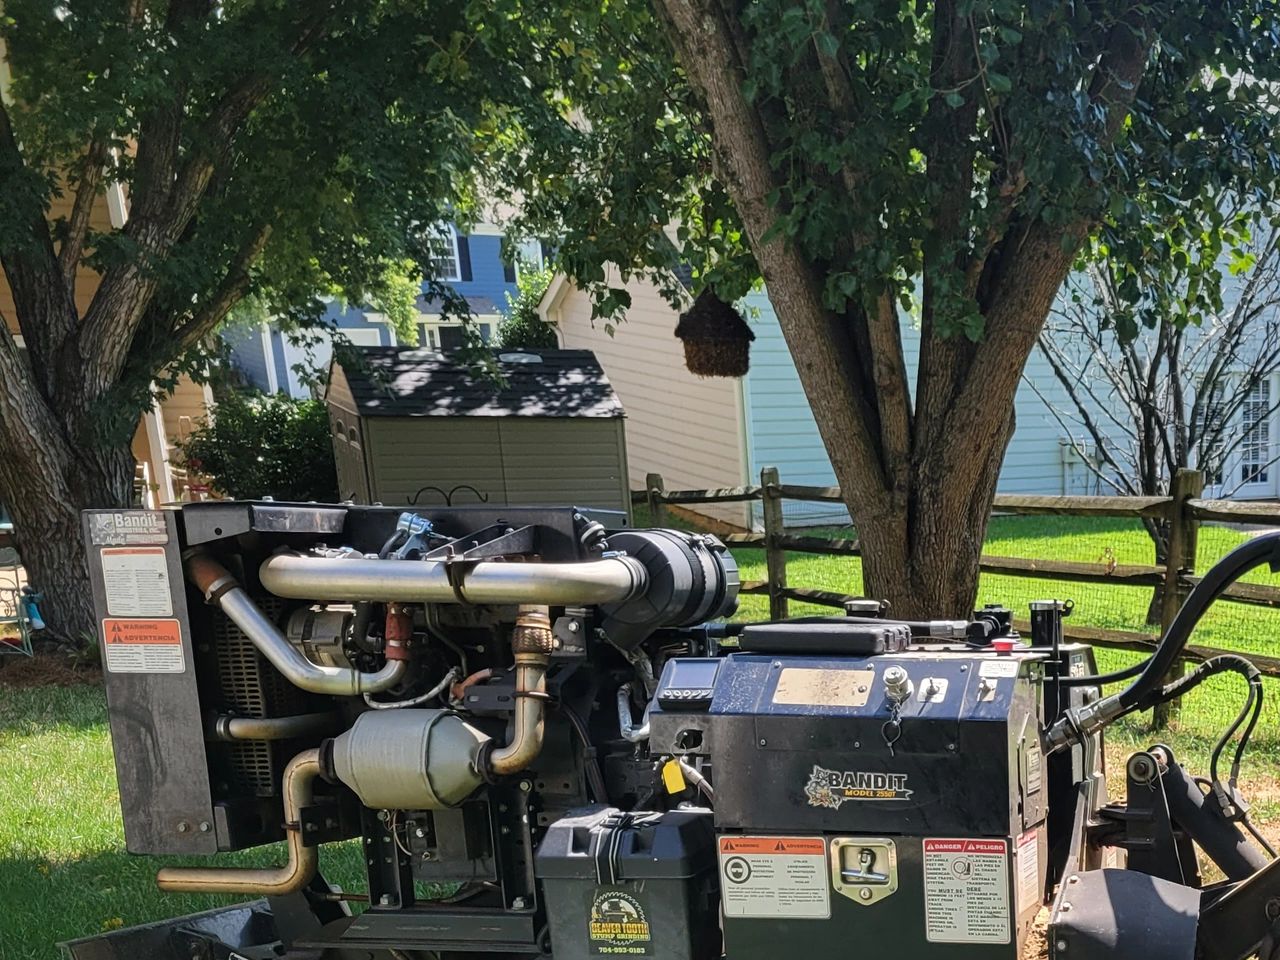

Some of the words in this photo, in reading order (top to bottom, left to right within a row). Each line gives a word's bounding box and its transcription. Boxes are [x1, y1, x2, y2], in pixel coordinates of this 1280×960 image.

[115, 513, 157, 527] Bandit
[828, 772, 907, 790] BANDIT
[592, 923, 621, 933] BEAVER
[622, 923, 648, 934] TOOTH
